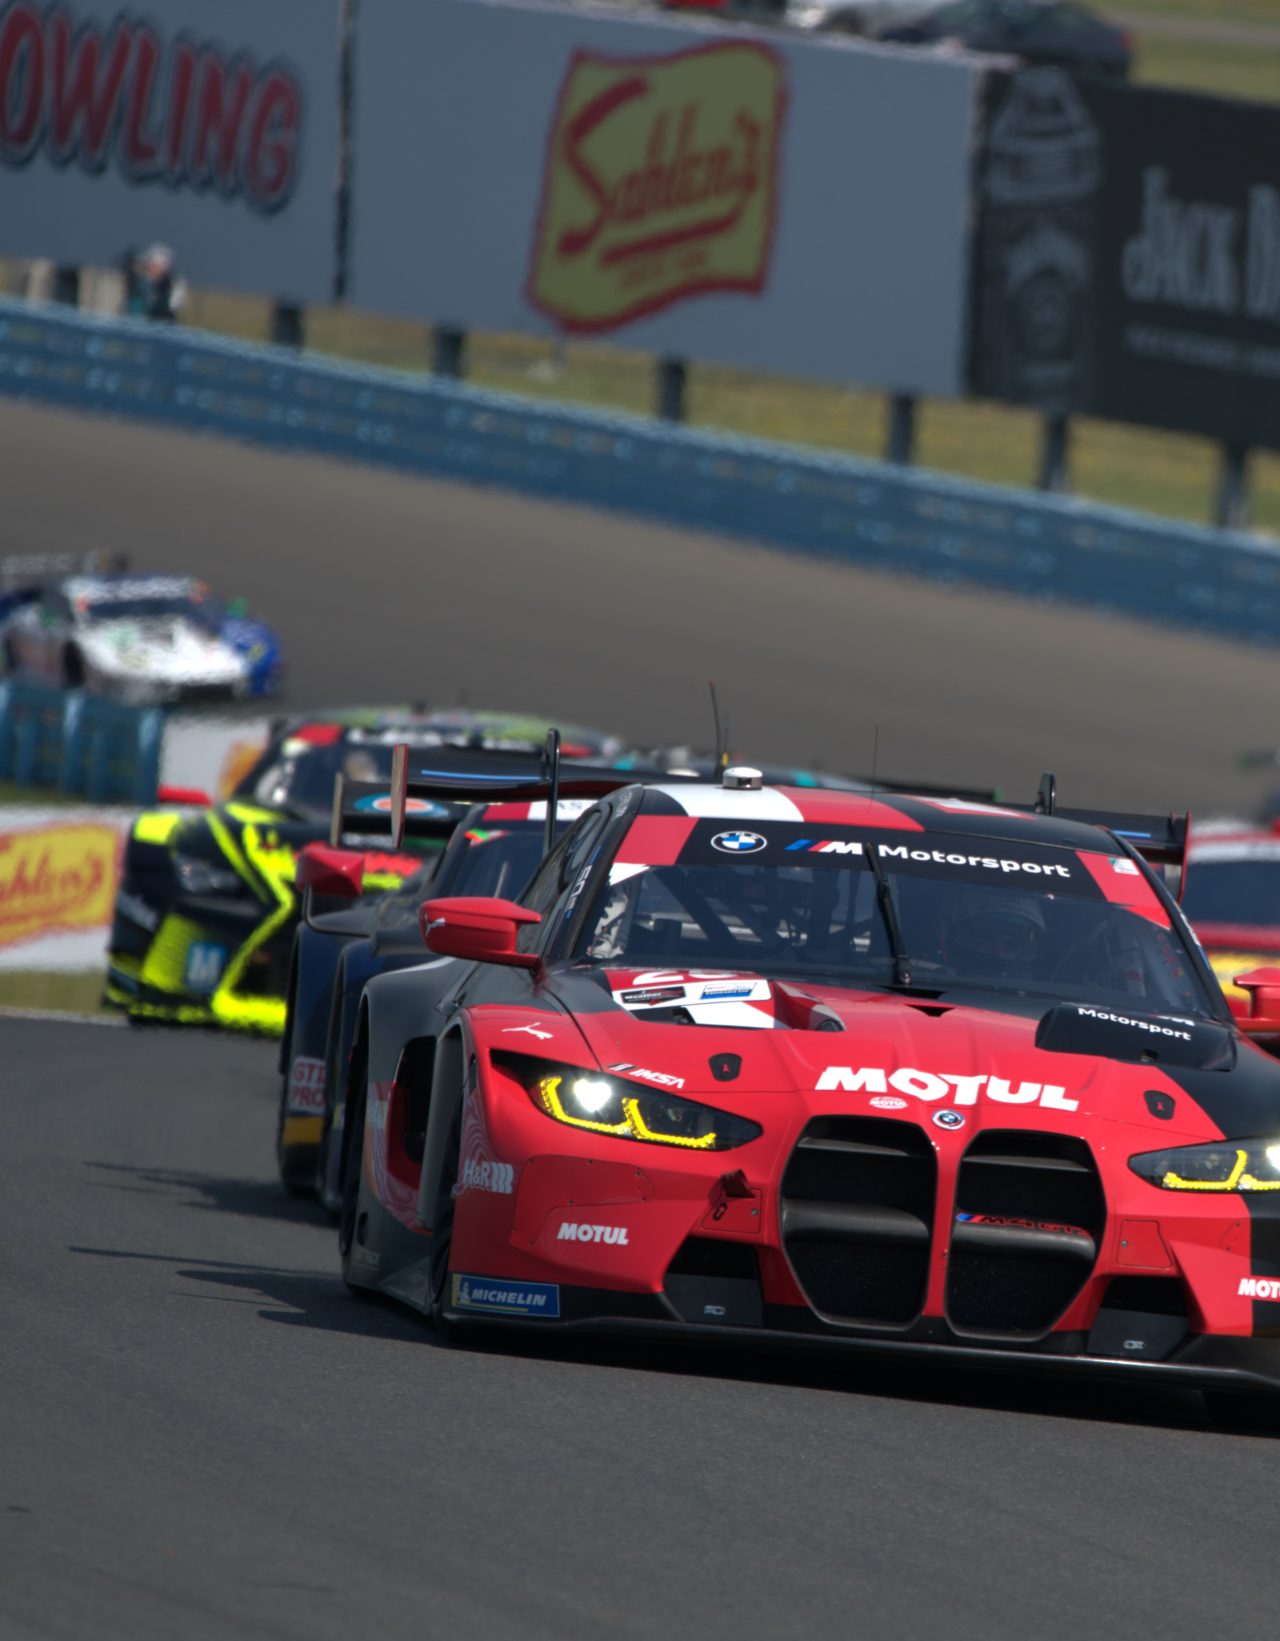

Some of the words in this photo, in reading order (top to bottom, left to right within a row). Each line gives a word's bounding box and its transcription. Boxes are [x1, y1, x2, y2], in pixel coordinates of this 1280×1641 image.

[878, 845, 1072, 878] Motorsport
[1077, 1007, 1192, 1041] Motorsport
[629, 1068, 685, 1089] IMSA
[815, 1066, 1080, 1112] MOTUL
[556, 1222, 629, 1245] MOTUL
[471, 1289, 547, 1306] MICHELIN
